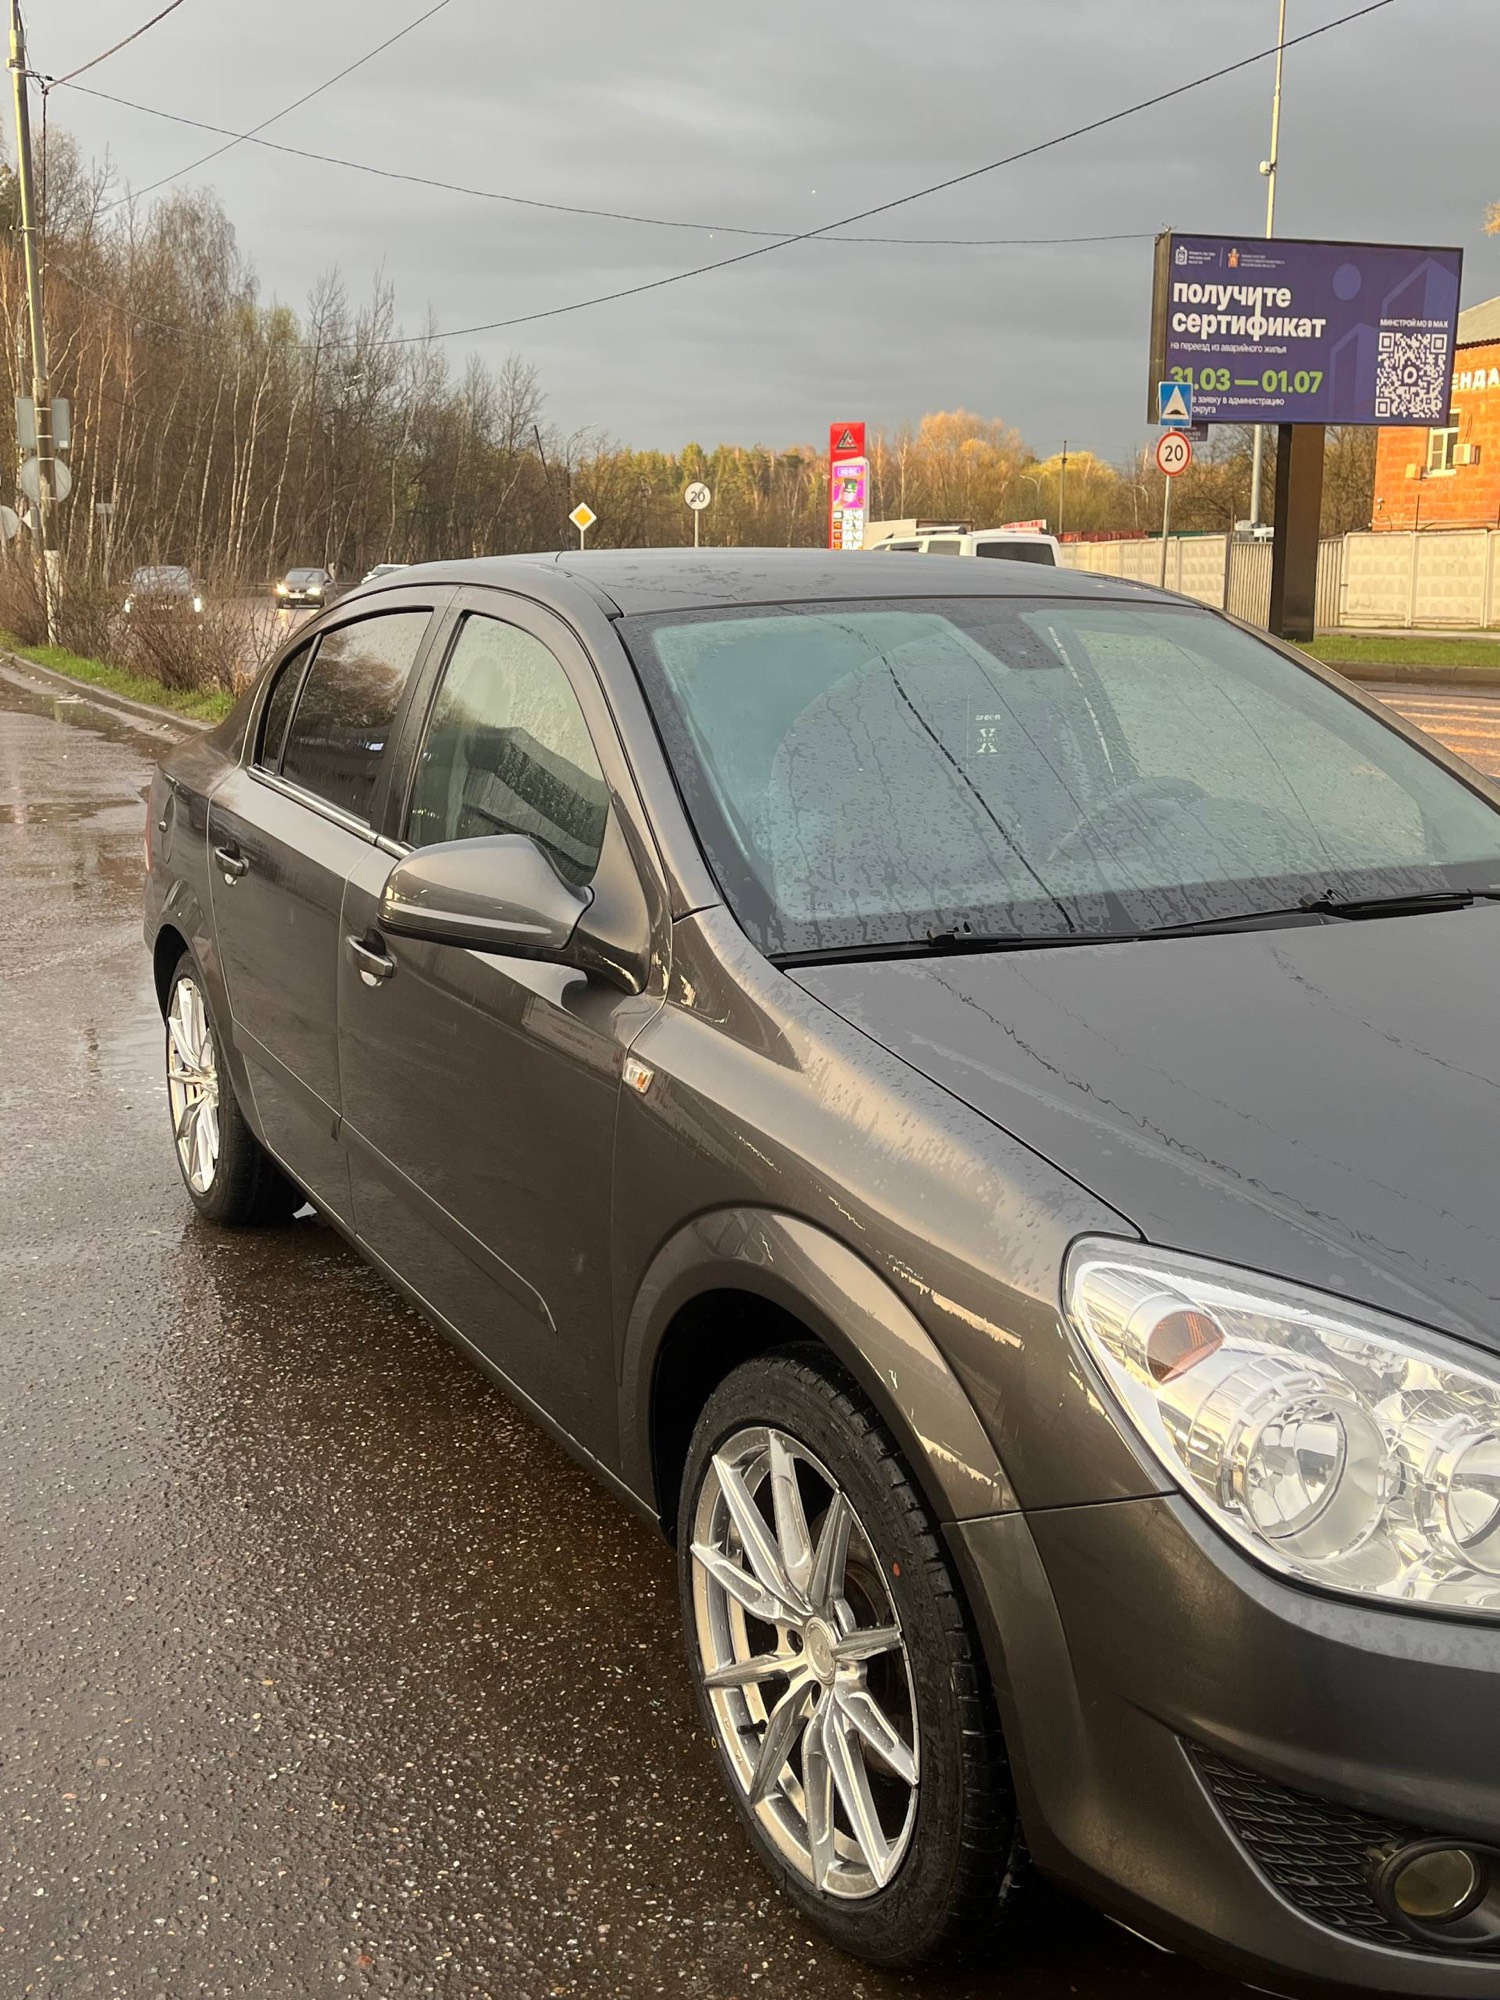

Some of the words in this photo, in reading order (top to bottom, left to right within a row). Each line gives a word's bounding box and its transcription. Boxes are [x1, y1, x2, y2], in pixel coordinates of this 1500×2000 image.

[1172, 282, 1292, 311] получите
[1171, 312, 1327, 342] сертификат
[1380, 318, 1416, 328] МИНСТРОЙ
[1170, 342, 1179, 350] на
[1181, 342, 1210, 352] переезд
[1211, 344, 1220, 352] из
[1221, 343, 1263, 353] аварийного
[1264, 345, 1287, 354] жилья
[1198, 396, 1221, 405] заявку
[1222, 396, 1227, 404] в
[1228, 396, 1285, 406] администрацию
[1192, 406, 1216, 415] округа
[1164, 444, 1184, 462] 20
[690, 491, 706, 503] 20
